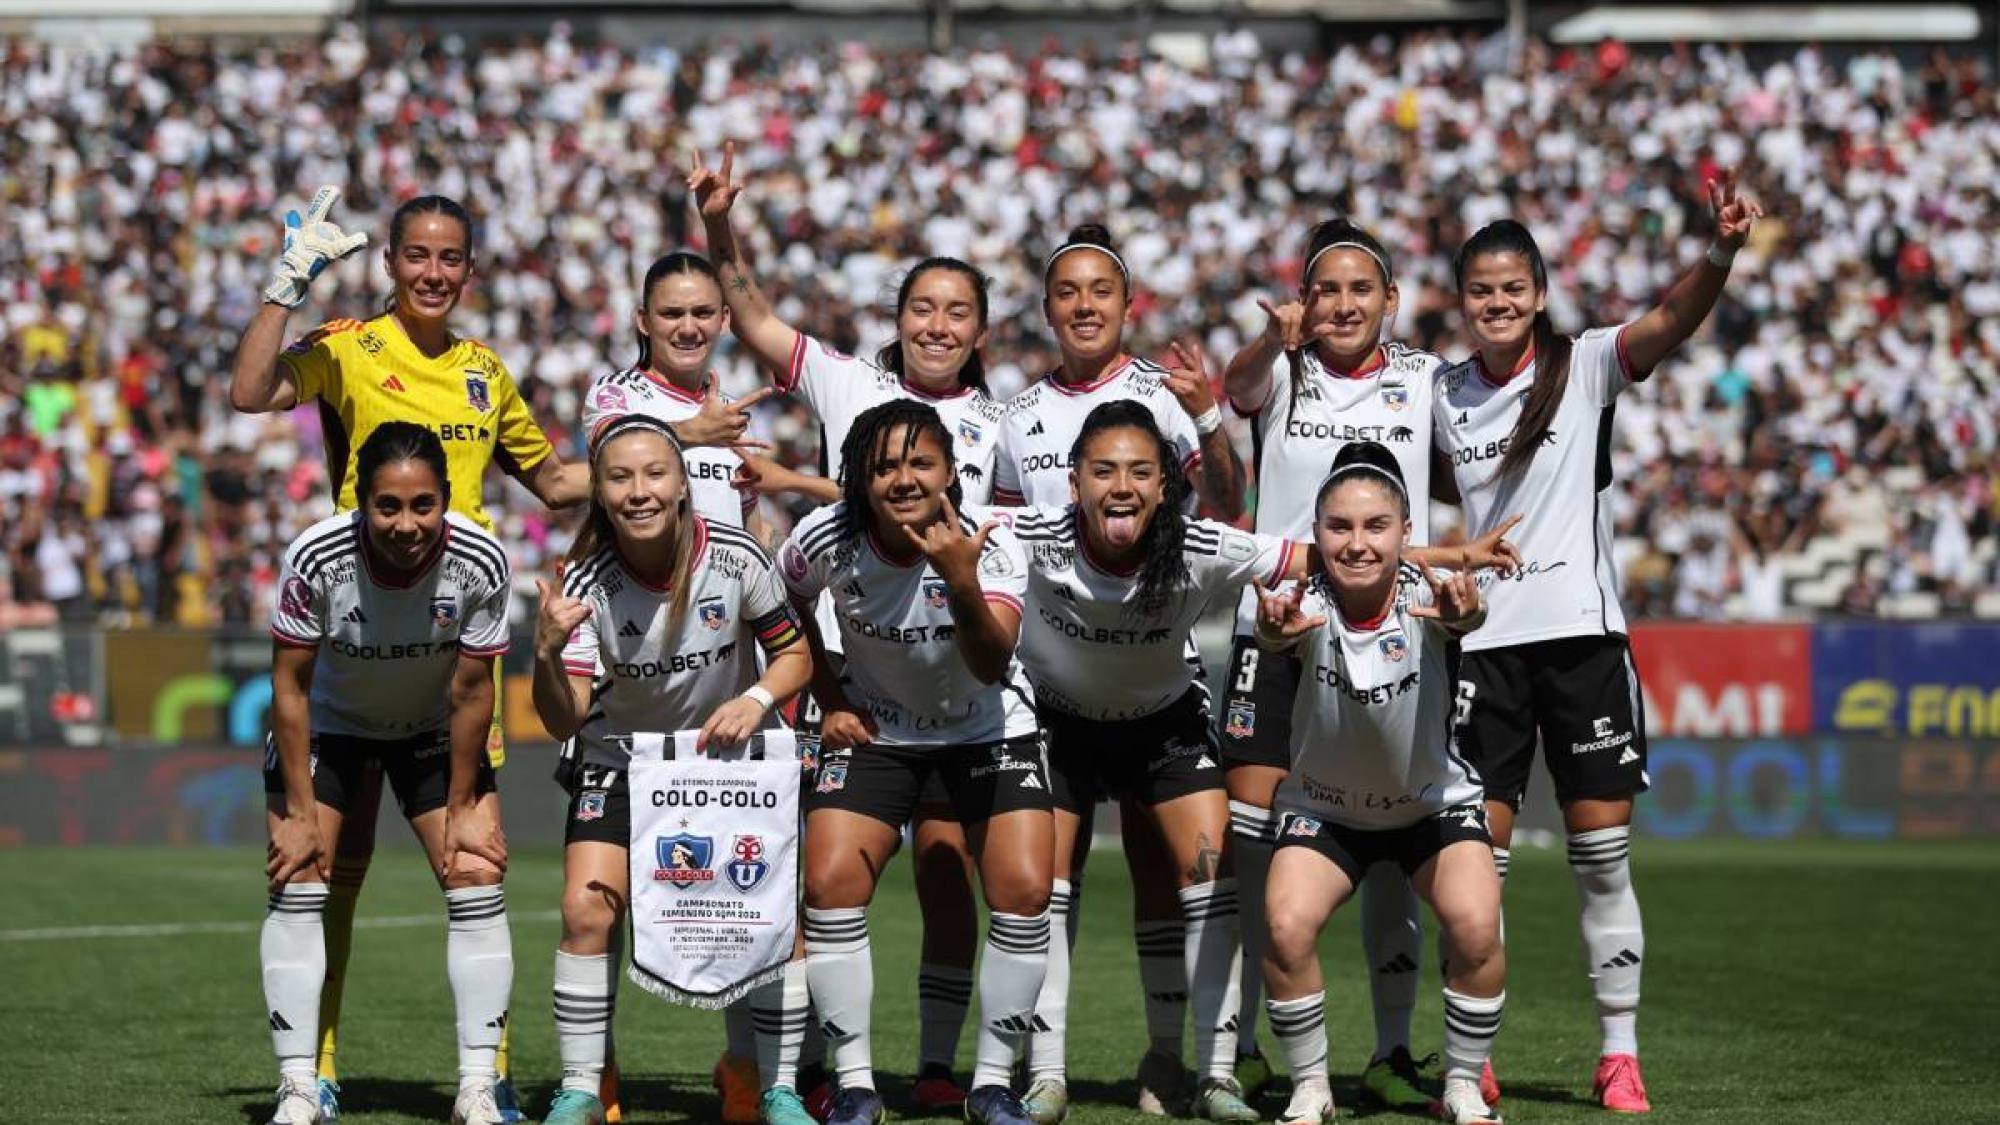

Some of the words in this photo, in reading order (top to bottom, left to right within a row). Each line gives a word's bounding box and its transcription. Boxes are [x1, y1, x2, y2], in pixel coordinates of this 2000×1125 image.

[427, 423, 475, 441] BET
[1288, 420, 1385, 442] COOLBET
[1455, 437, 1511, 467] OOLBE
[1040, 608, 1136, 645] COOLBET
[332, 640, 432, 661] COOLBET
[613, 649, 710, 679] COOLBET
[1236, 648, 1259, 692] 3
[1316, 664, 1395, 706] COOLBET
[1572, 731, 1633, 755] BancoEstado
[652, 789, 777, 809] COLO-COLO
[1640, 741, 2000, 838] OOLB
[655, 870, 712, 880] COLO-COLO
[734, 864, 761, 886] U
[662, 909, 712, 918] FEMENINO
[737, 910, 761, 919] 2023
[676, 899, 744, 909] CAMPEONATO
